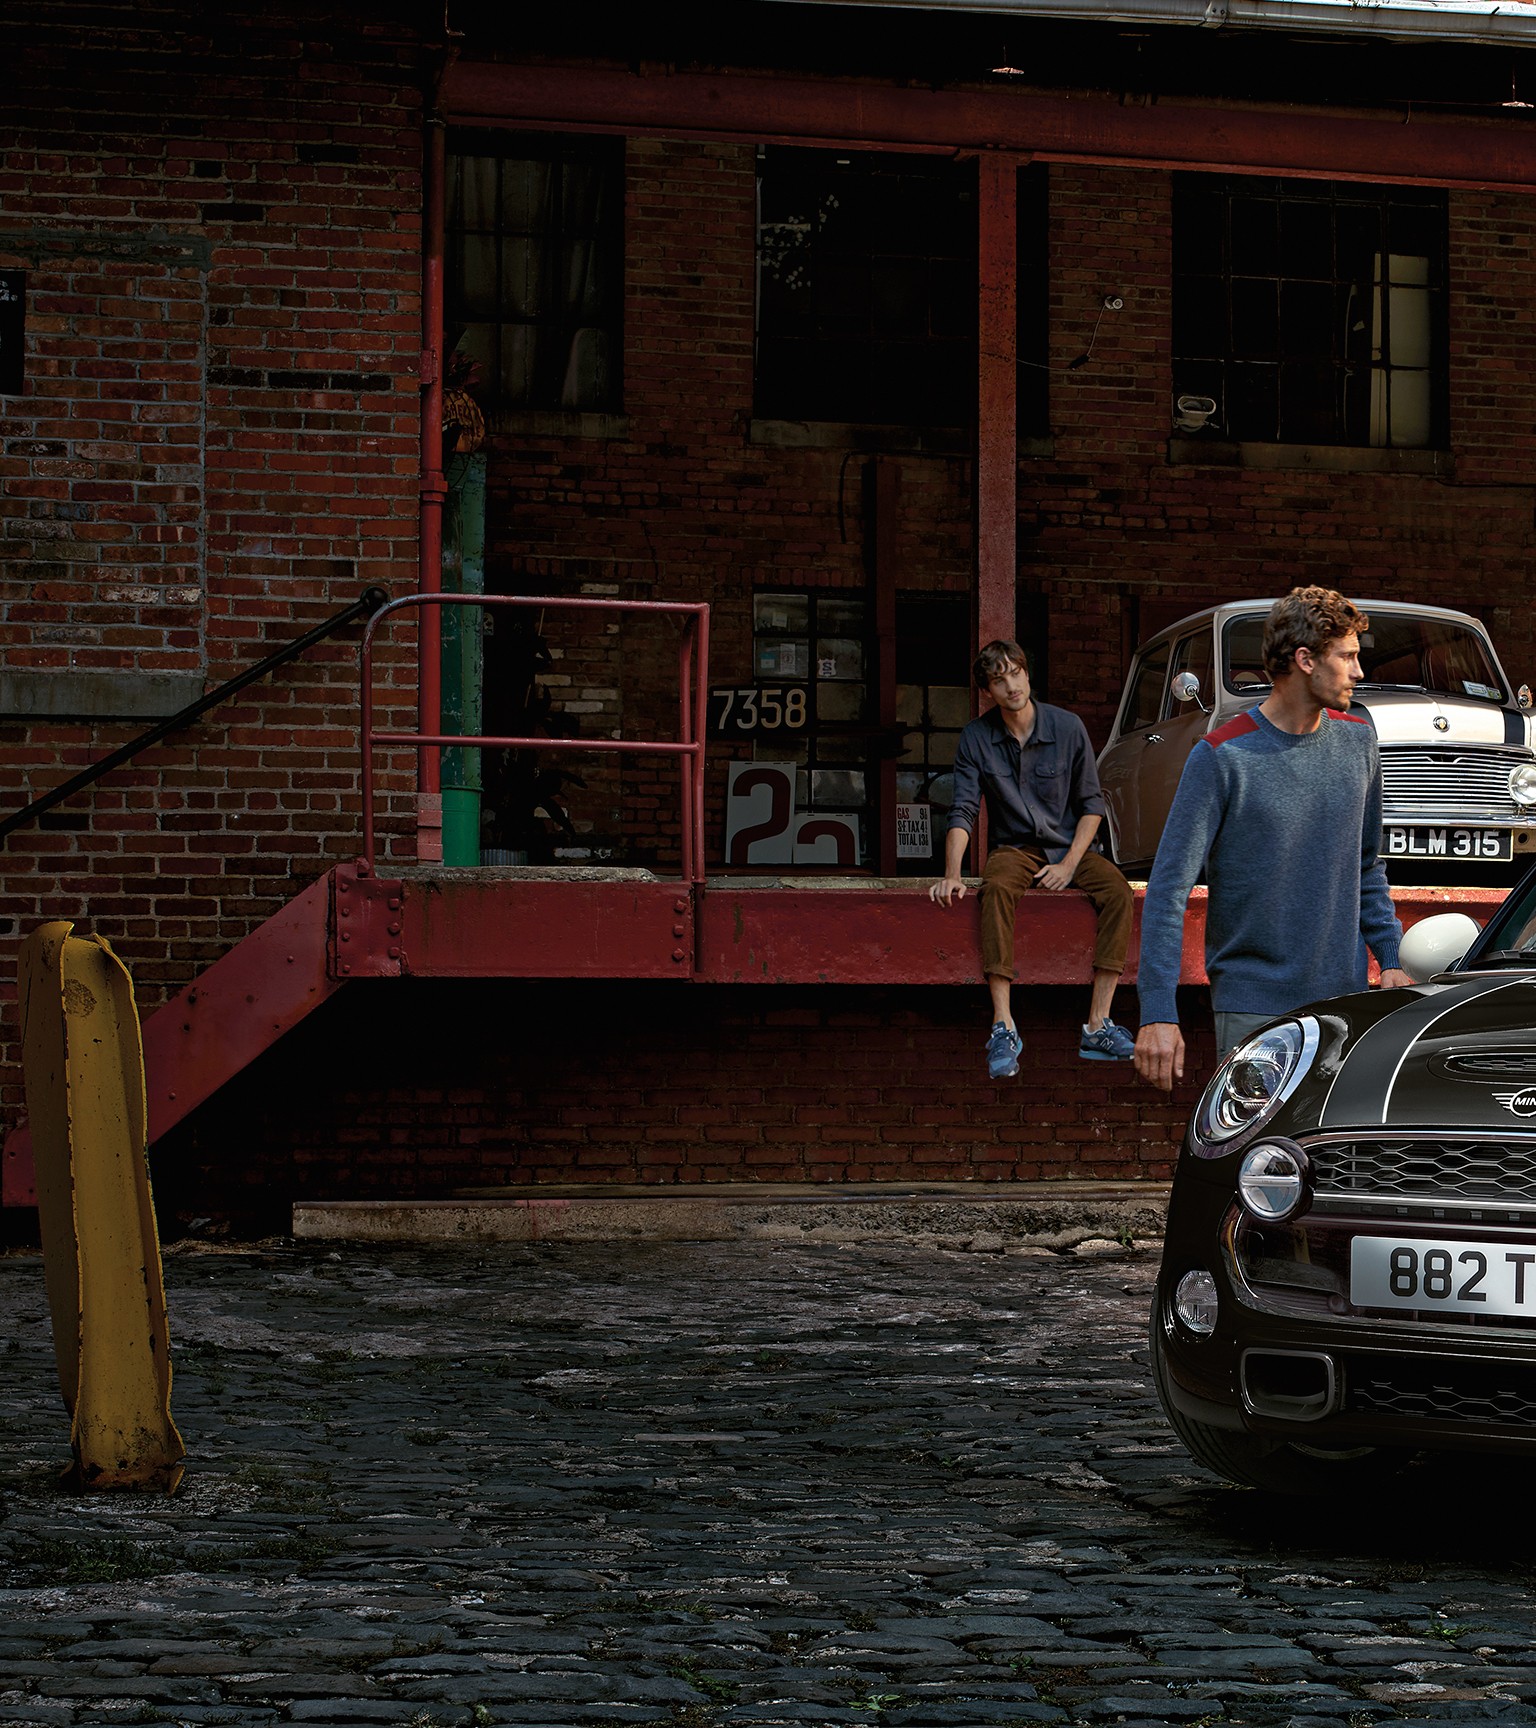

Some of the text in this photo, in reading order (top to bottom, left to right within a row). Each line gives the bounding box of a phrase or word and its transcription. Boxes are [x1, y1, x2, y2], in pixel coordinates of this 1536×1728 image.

[712, 688, 807, 730] 7358
[897, 807, 910, 820] GAS
[898, 833, 918, 846] TOTAL
[1389, 827, 1500, 856] BLM 315
[1389, 1247, 1488, 1302] 882
